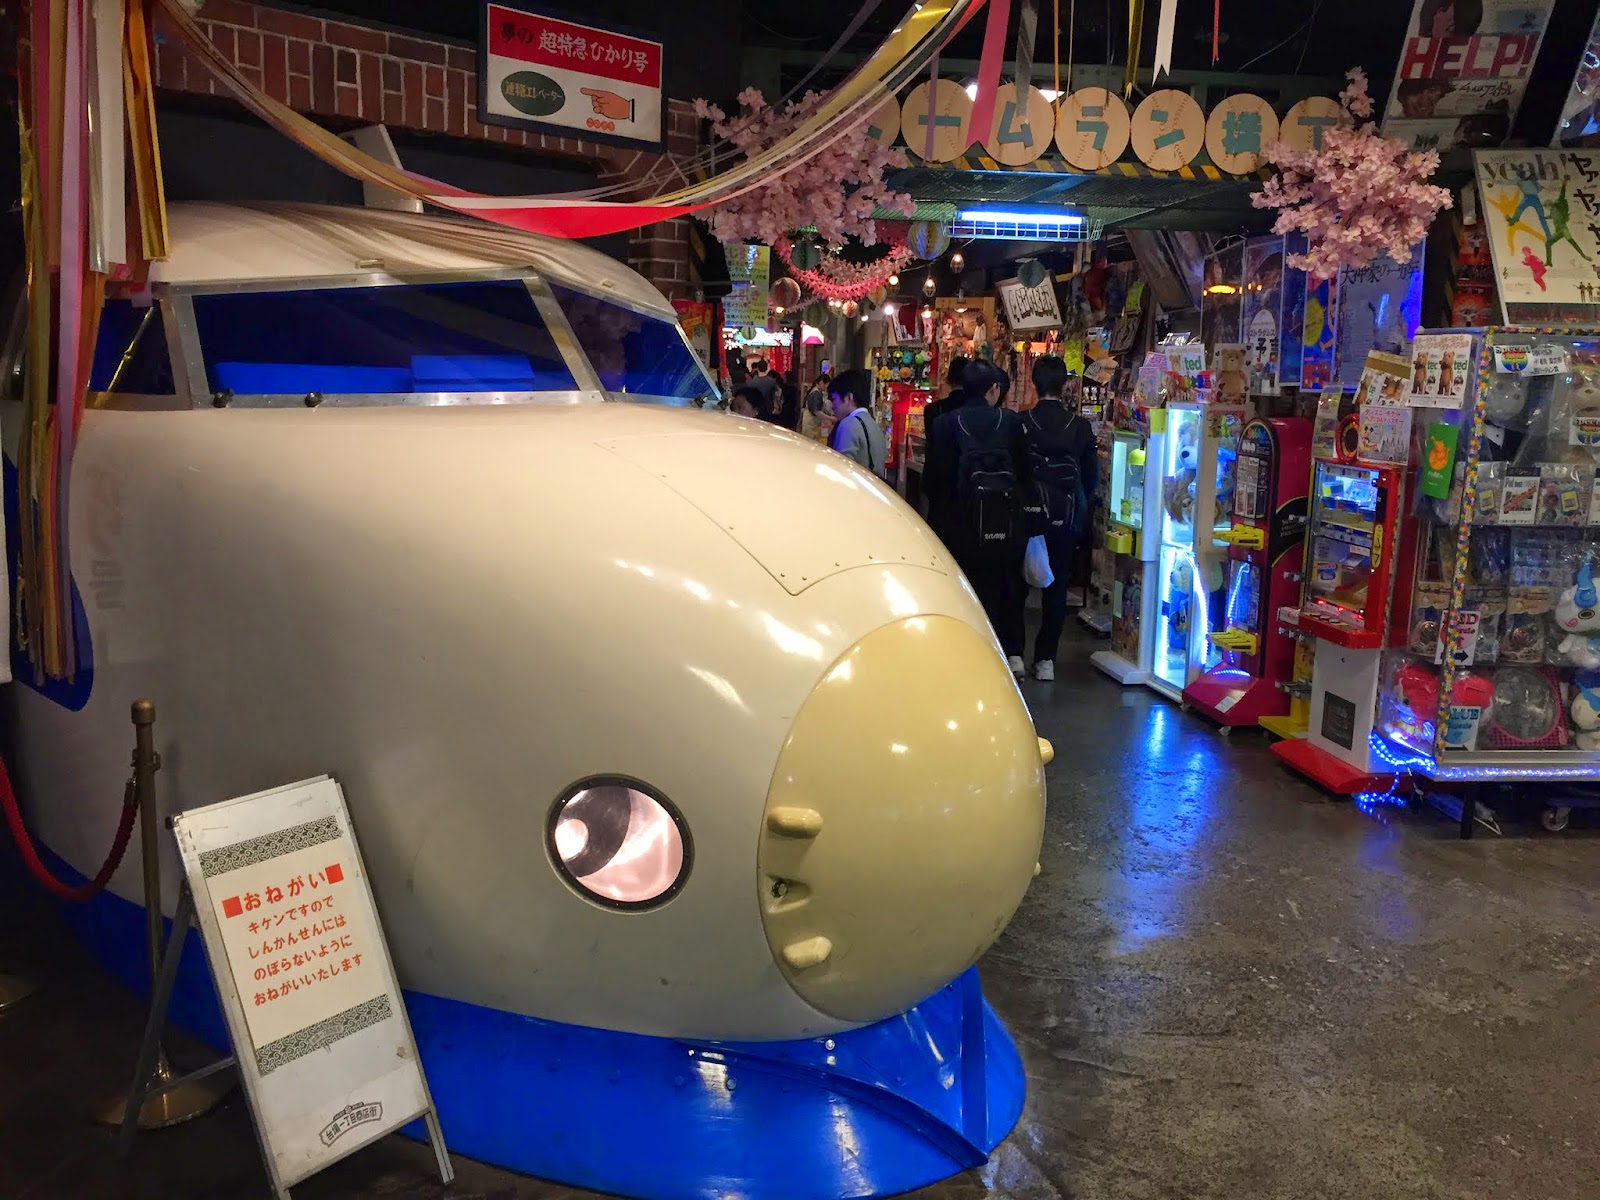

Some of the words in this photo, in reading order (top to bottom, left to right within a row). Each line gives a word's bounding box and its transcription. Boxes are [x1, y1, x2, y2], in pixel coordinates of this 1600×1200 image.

[538, 29, 648, 73] 超特急ひかり号
[1400, 33, 1540, 80] HELP!
[1454, 360, 1468, 370] ted
[244, 870, 326, 911] おねがい
[248, 896, 334, 934] キケンですので
[248, 914, 347, 959] しんかんせんには
[253, 934, 352, 981] のぼらないように
[253, 953, 363, 1006] おねがいいたします
[326, 1106, 377, 1141] 台場一丁目商店街
